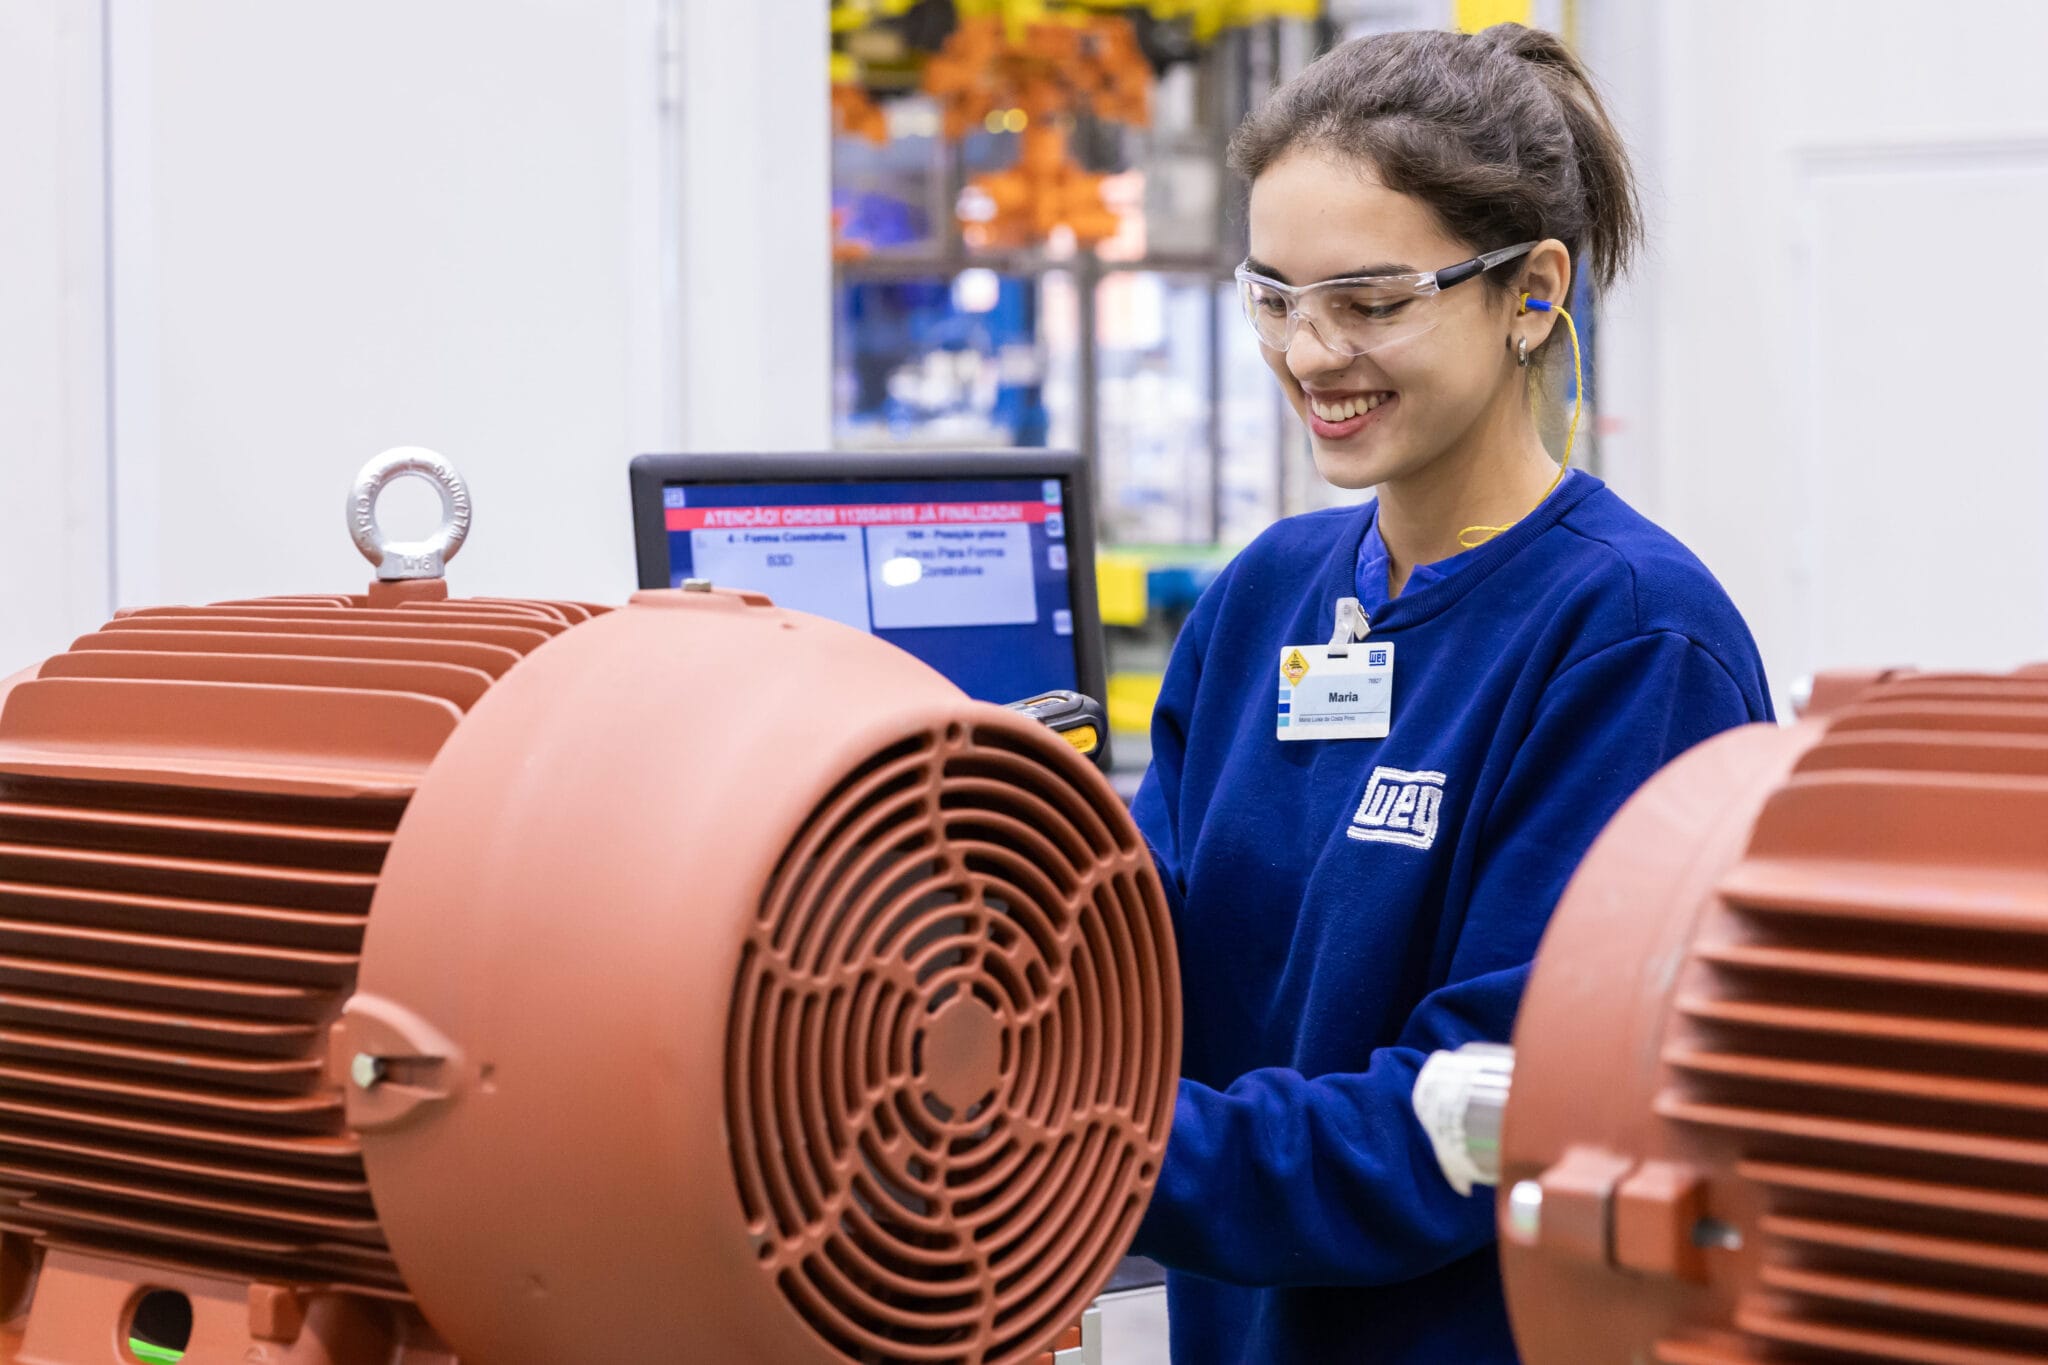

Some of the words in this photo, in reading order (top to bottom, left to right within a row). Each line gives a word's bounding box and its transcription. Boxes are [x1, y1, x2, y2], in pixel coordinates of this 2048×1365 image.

[782, 508, 836, 524] ORDEM
[744, 533, 780, 543] Forma
[967, 545, 1005, 557] Forma
[1328, 691, 1359, 703] Maria
